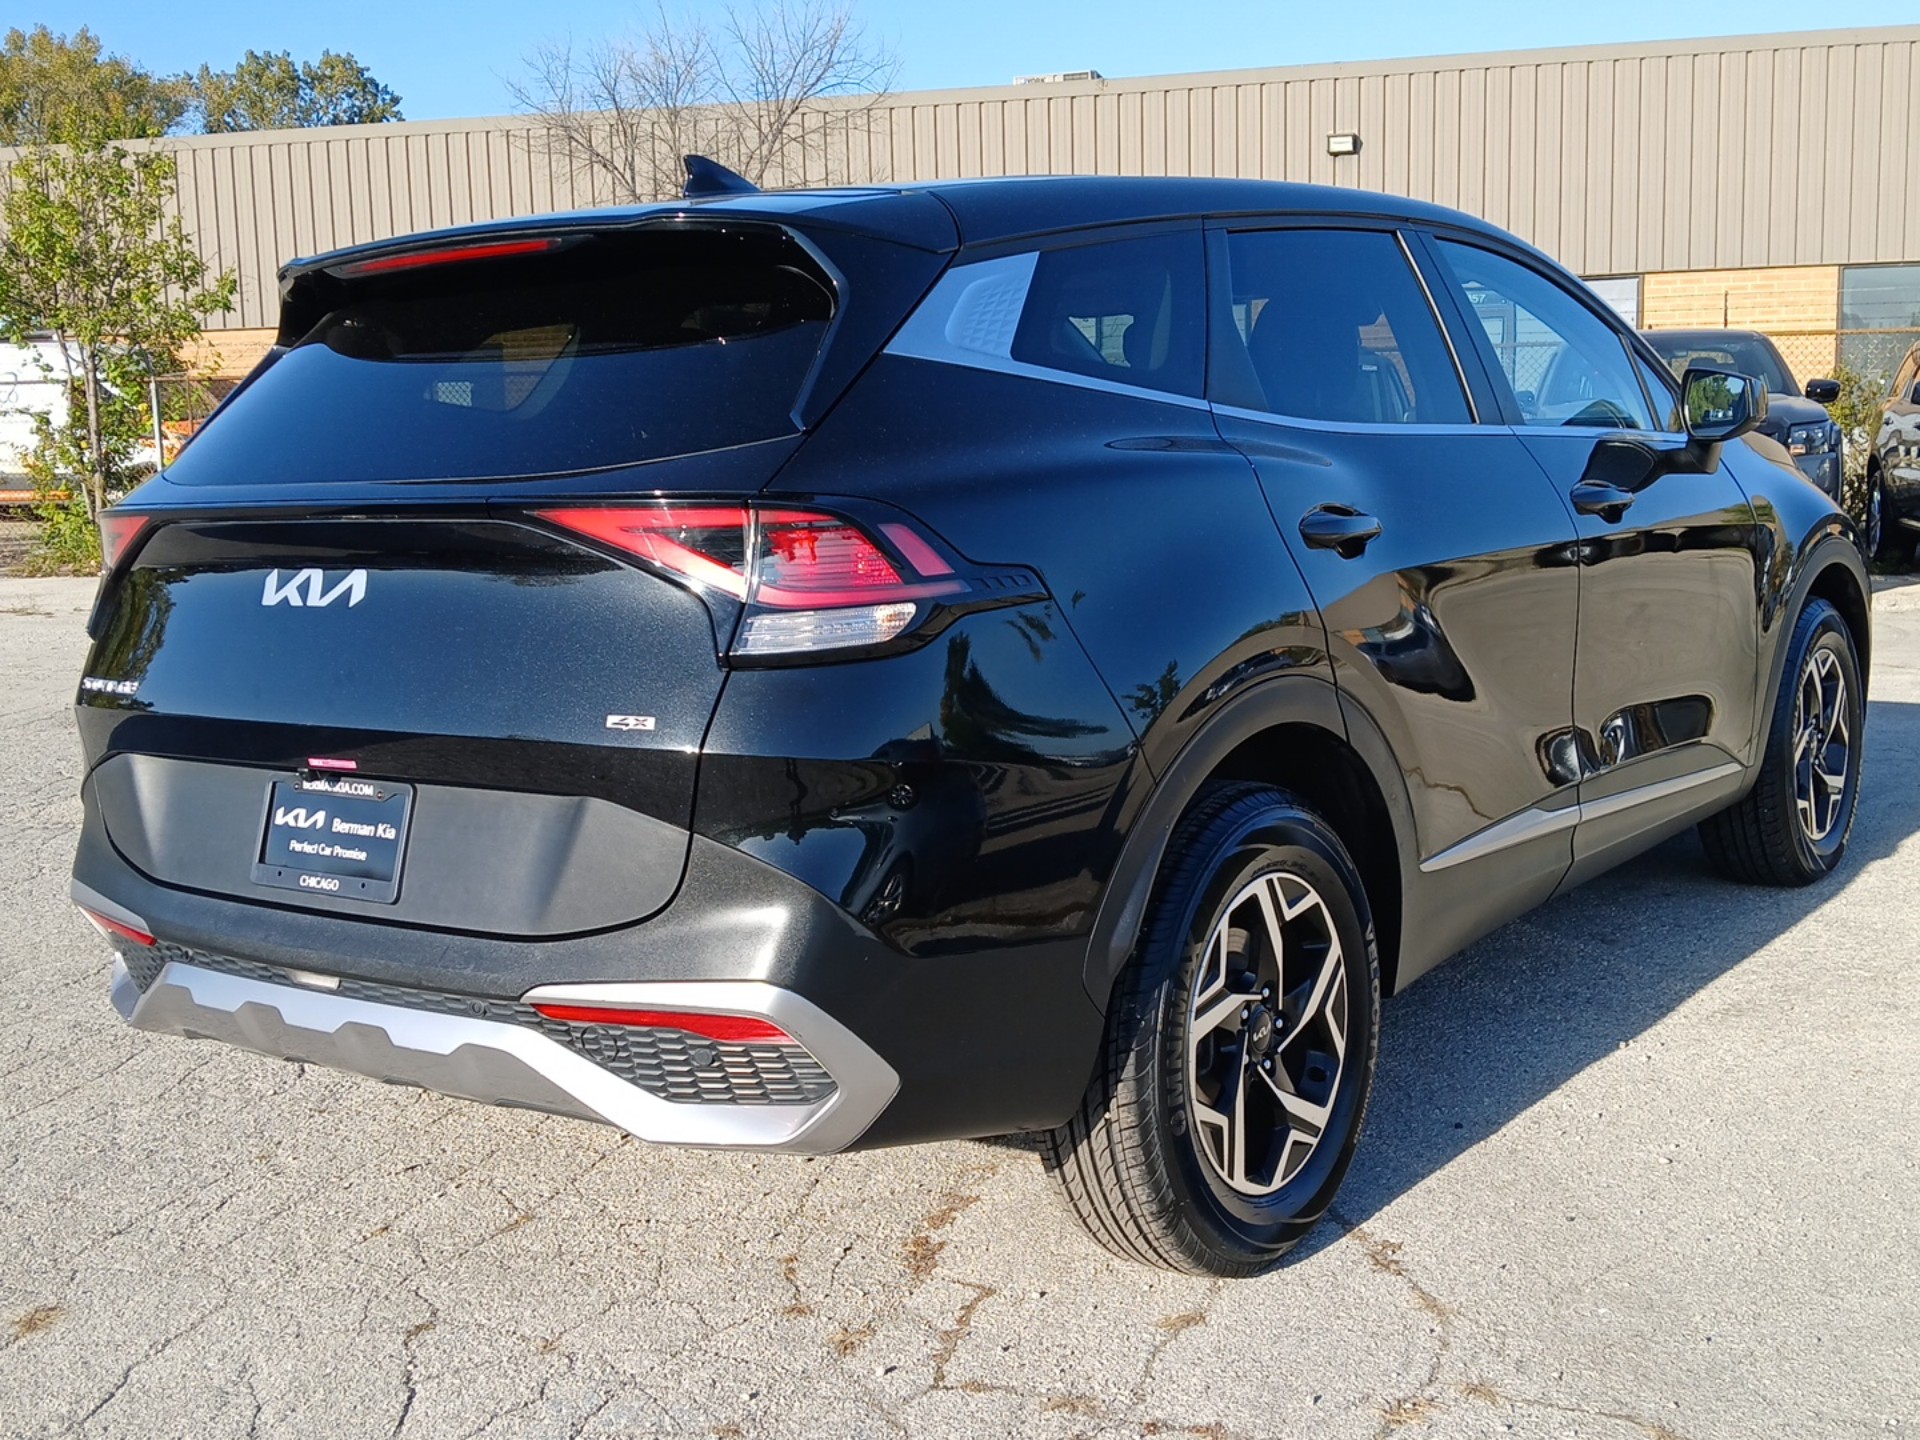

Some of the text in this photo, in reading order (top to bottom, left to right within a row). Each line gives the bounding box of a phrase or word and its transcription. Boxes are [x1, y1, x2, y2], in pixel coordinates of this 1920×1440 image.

[331, 818, 397, 840] Berman Kia
[289, 840, 367, 861] Perfect Car Promise
[299, 875, 340, 891] CHICAGO
